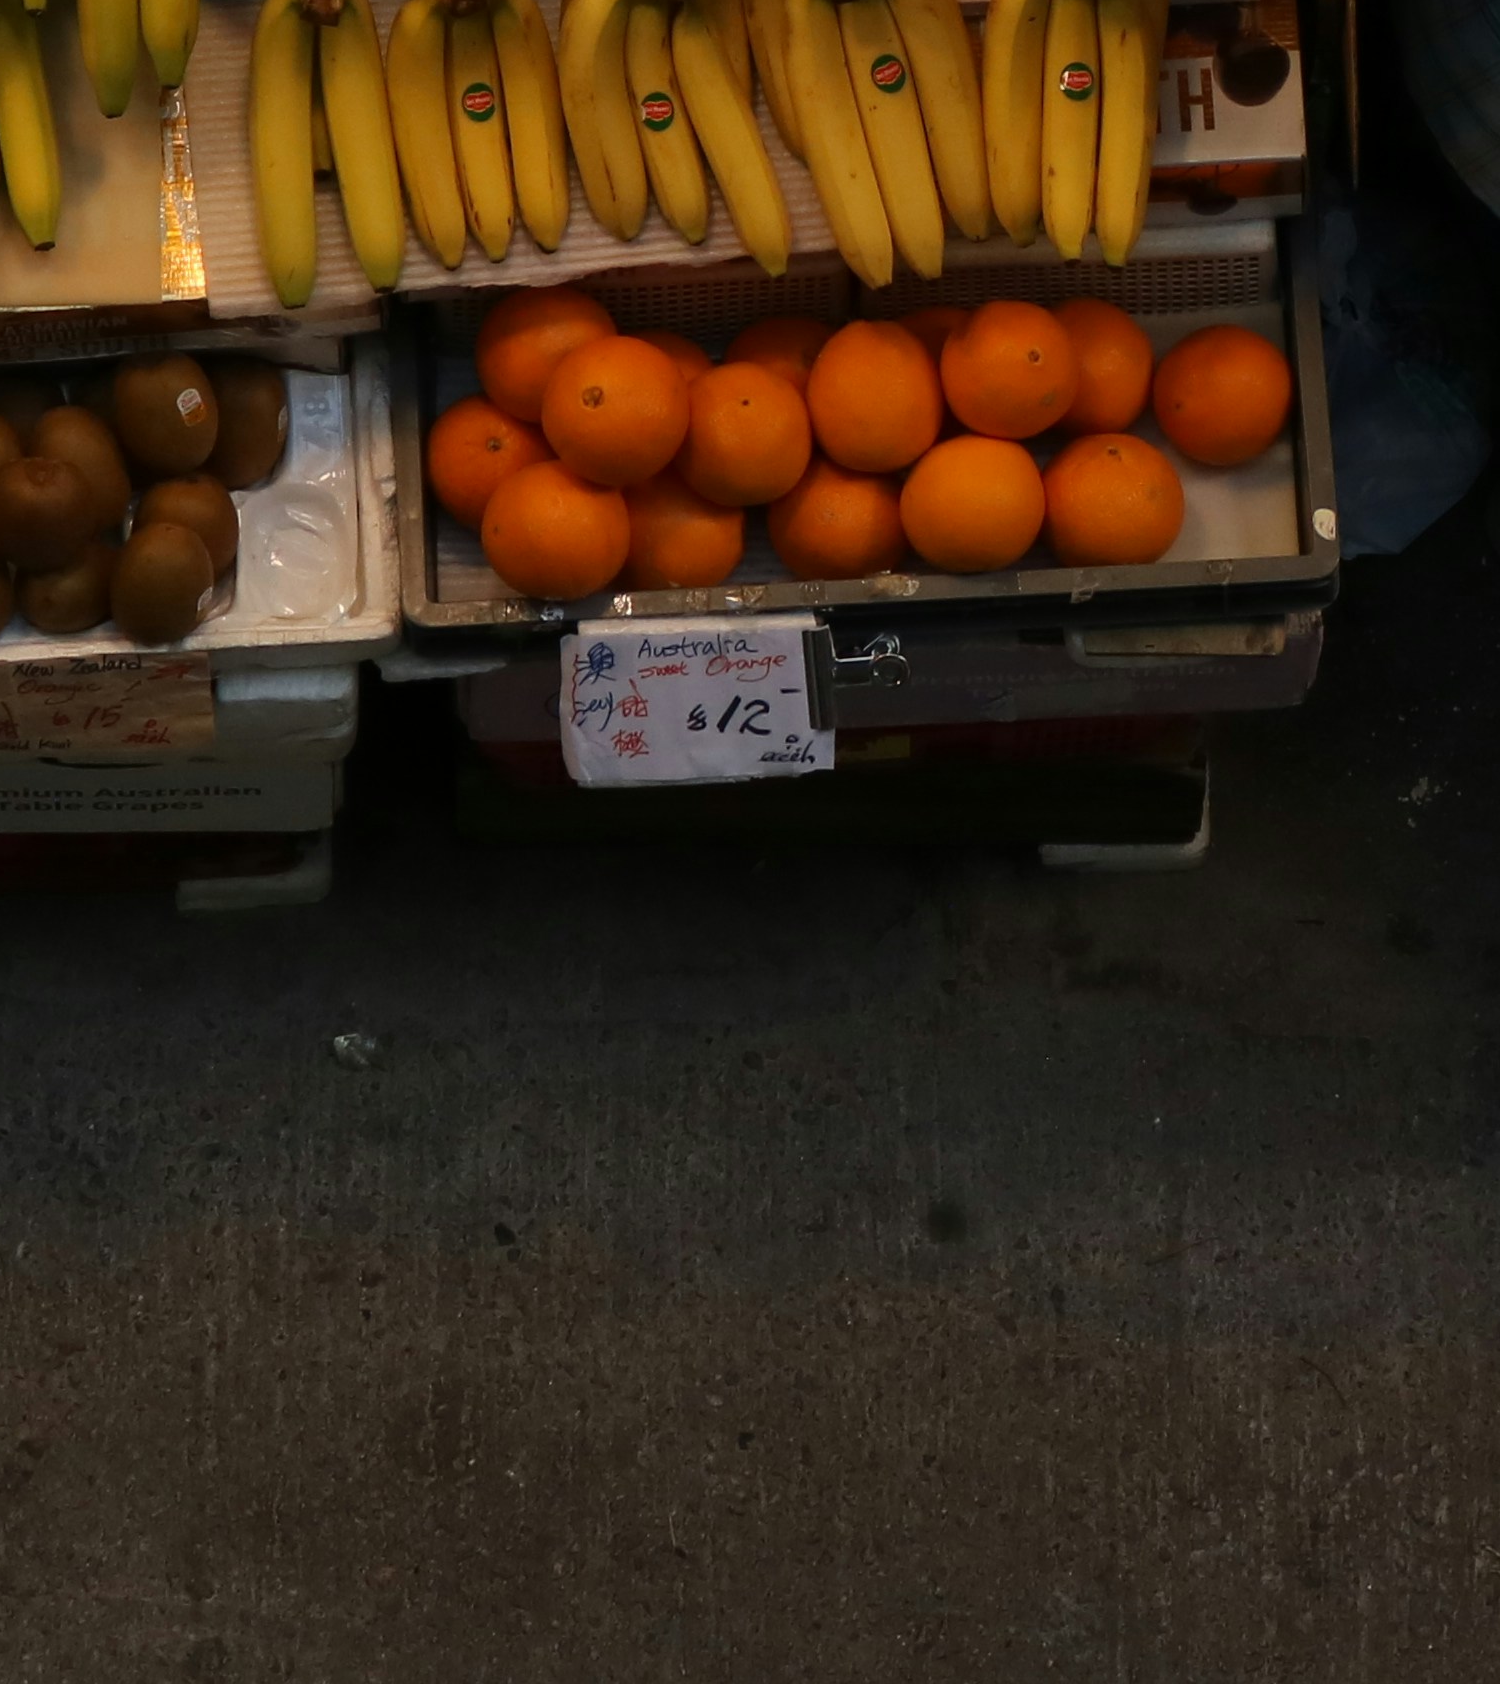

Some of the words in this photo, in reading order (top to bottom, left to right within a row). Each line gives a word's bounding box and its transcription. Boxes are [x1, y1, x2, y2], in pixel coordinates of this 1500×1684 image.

[637, 633, 758, 660] Australia
[705, 654, 787, 684] Orange
[98, 785, 263, 800] Australian
[95, 799, 206, 814] Grapes
